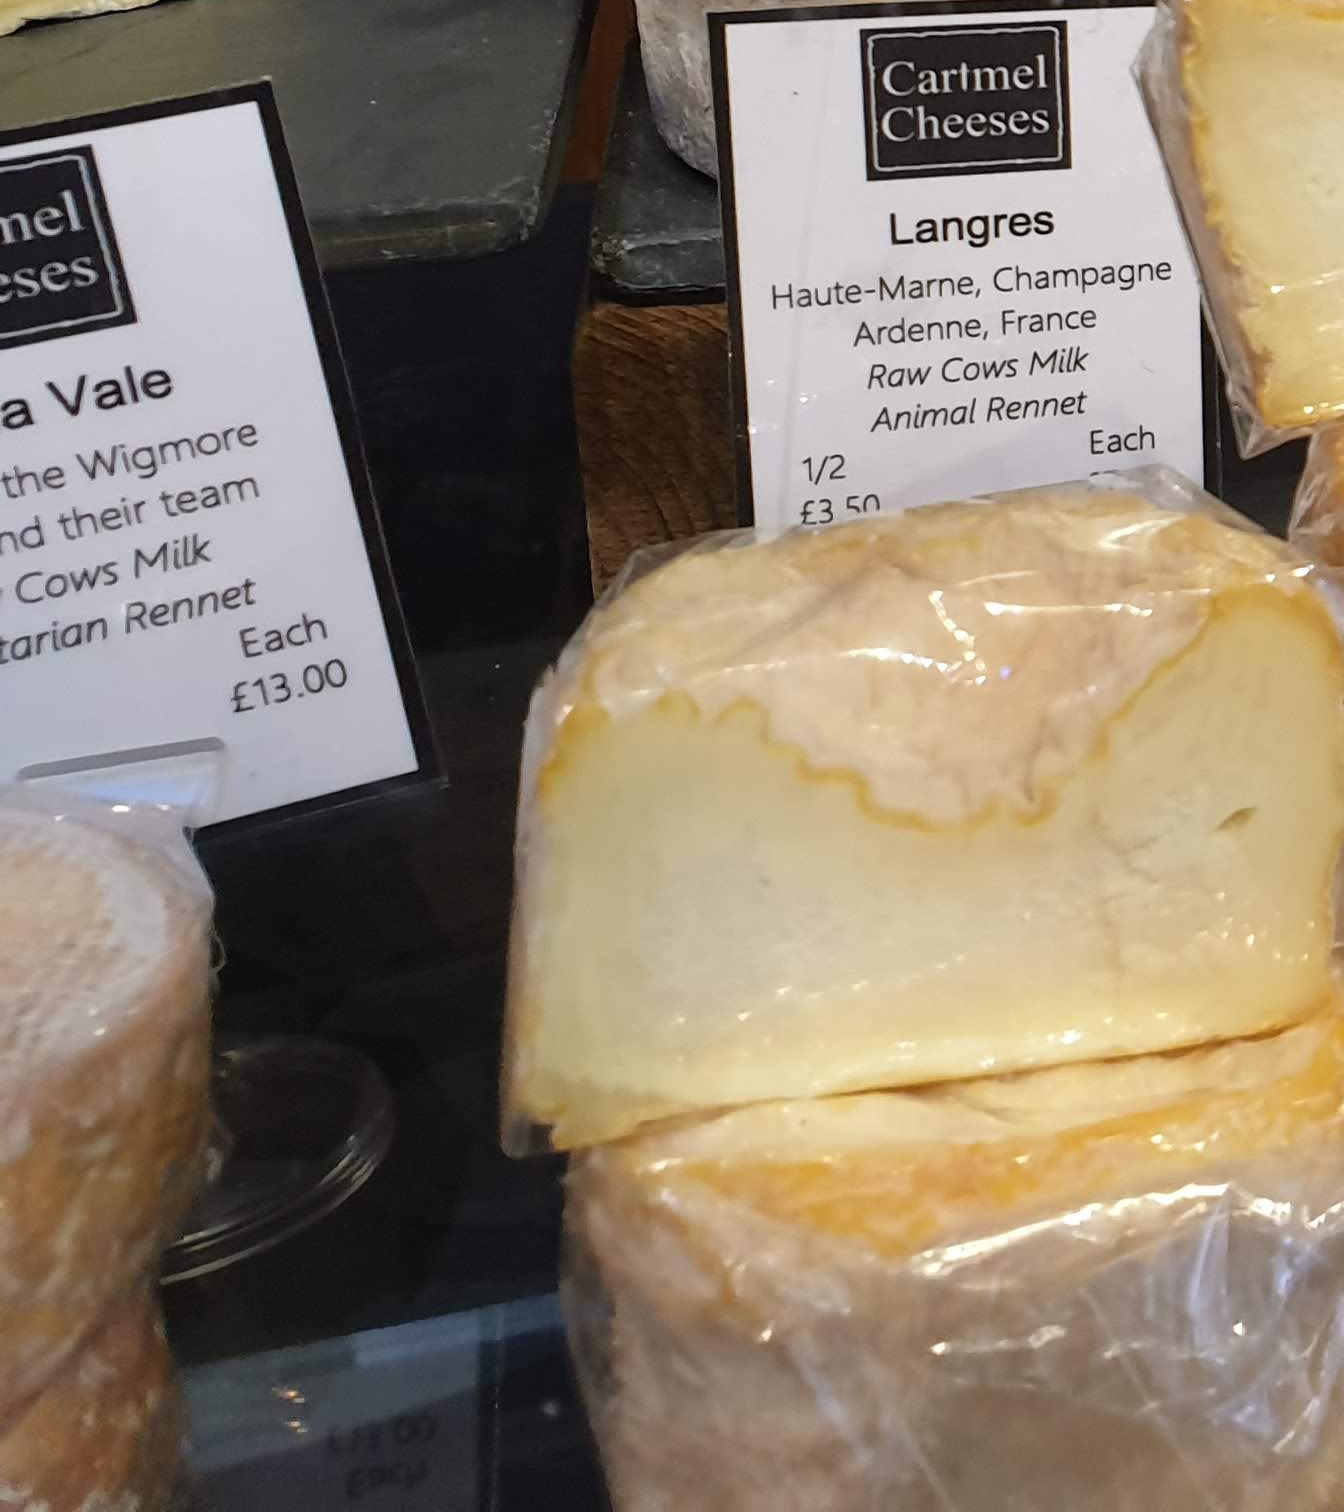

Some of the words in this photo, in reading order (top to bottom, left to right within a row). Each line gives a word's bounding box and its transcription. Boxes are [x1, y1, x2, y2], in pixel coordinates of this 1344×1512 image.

[883, 54, 1048, 97] Cartmel
[881, 106, 1049, 142] Cheeses
[889, 211, 1055, 249] Langres
[771, 275, 981, 310] Haute-Marne,
[992, 261, 1172, 294] Champagne
[853, 317, 989, 347] Ardenne,
[1001, 309, 1097, 336] France
[867, 363, 932, 390] Raw
[941, 356, 1019, 383] Cows
[1028, 346, 1089, 376] Milk
[44, 365, 174, 417] Vale
[870, 397, 977, 433] Animal
[986, 390, 1088, 423] Rennet
[0, 465, 66, 499] the
[75, 424, 259, 481] Wigmore
[1090, 424, 1156, 455] Each
[802, 454, 847, 486] 1/2
[56, 497, 147, 541] their
[158, 477, 260, 518] team
[15, 561, 119, 604] Cows
[133, 533, 212, 579] Milk
[124, 577, 257, 635] Rennet
[239, 613, 328, 659] Each
[230, 658, 348, 713] £13.00
